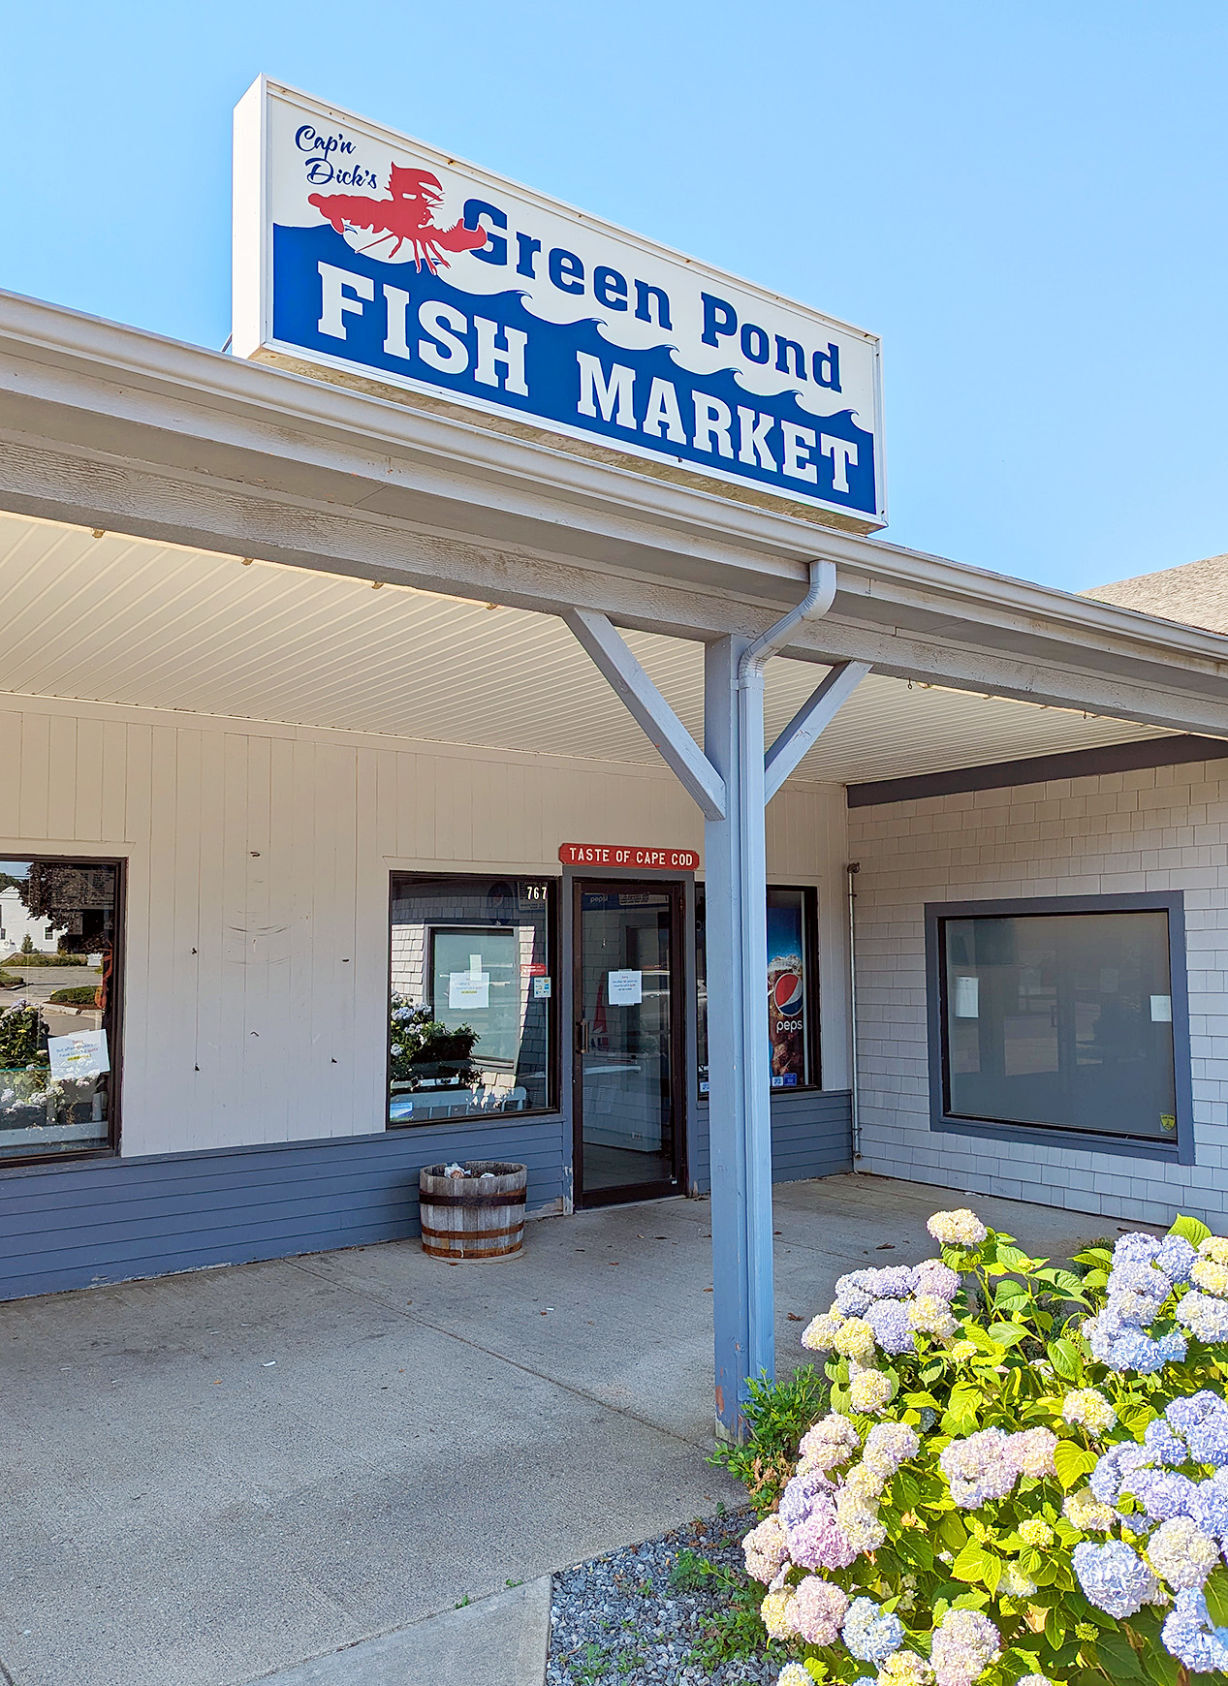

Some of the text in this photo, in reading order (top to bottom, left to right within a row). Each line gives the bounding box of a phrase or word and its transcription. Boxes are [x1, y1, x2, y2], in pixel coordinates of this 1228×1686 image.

[294, 125, 356, 160] Cap'n
[304, 157, 377, 189] Dick's
[463, 198, 842, 393] Green Pond
[317, 260, 858, 493] FISH MARKET
[569, 847, 693, 866] TASTE OF CAPE COD
[527, 886, 547, 900] 767
[776, 1019, 804, 1034] peps
